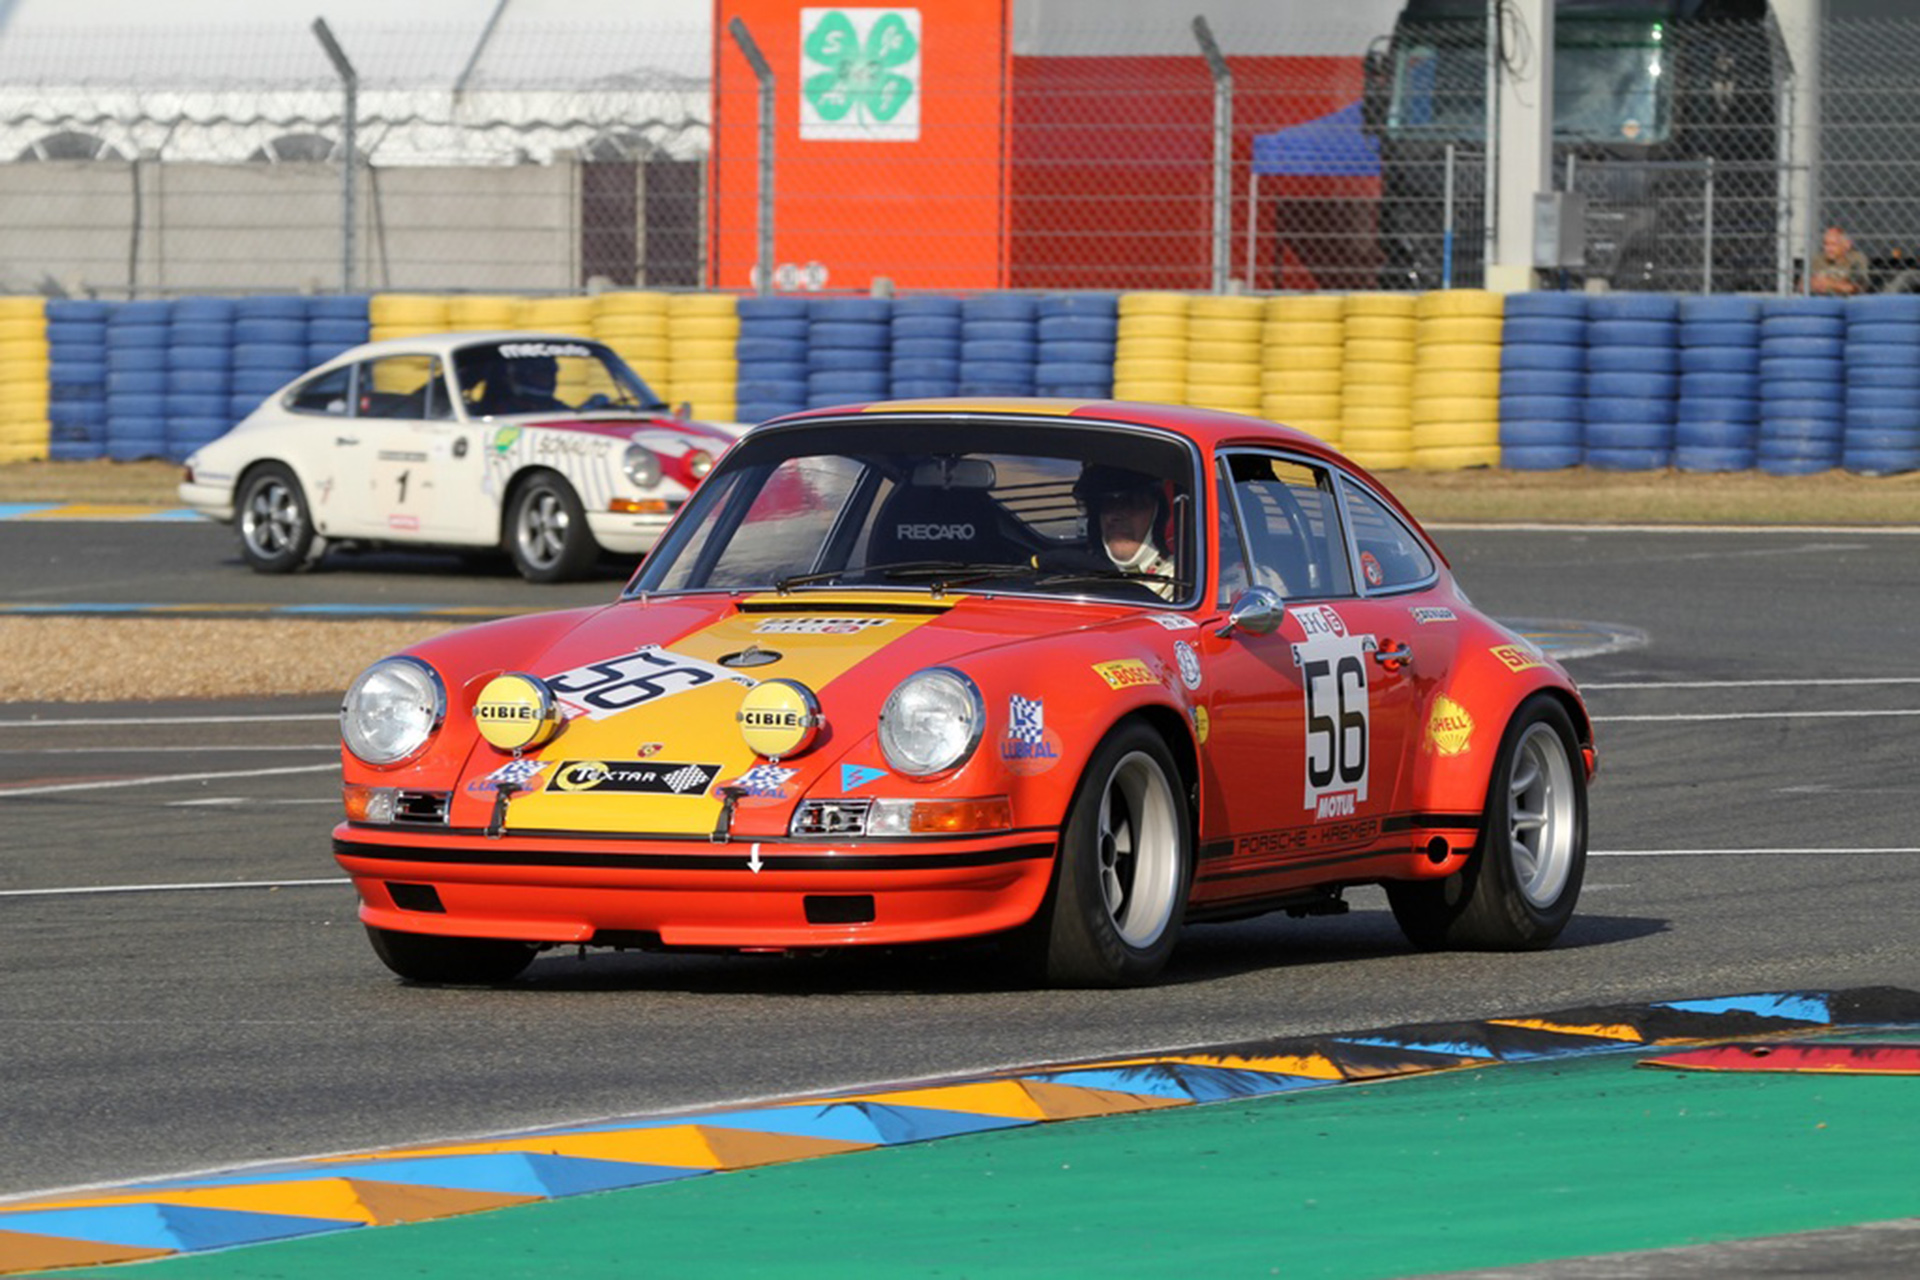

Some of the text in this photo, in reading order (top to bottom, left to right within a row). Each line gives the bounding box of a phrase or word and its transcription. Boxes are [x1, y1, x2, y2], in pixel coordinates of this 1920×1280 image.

[397, 470, 409, 503] 1
[898, 524, 975, 540] RECARO
[547, 652, 715, 709] 56
[1304, 656, 1367, 788] 56
[1317, 793, 1355, 820] MOTUL
[1238, 829, 1307, 855] PORSCHE
